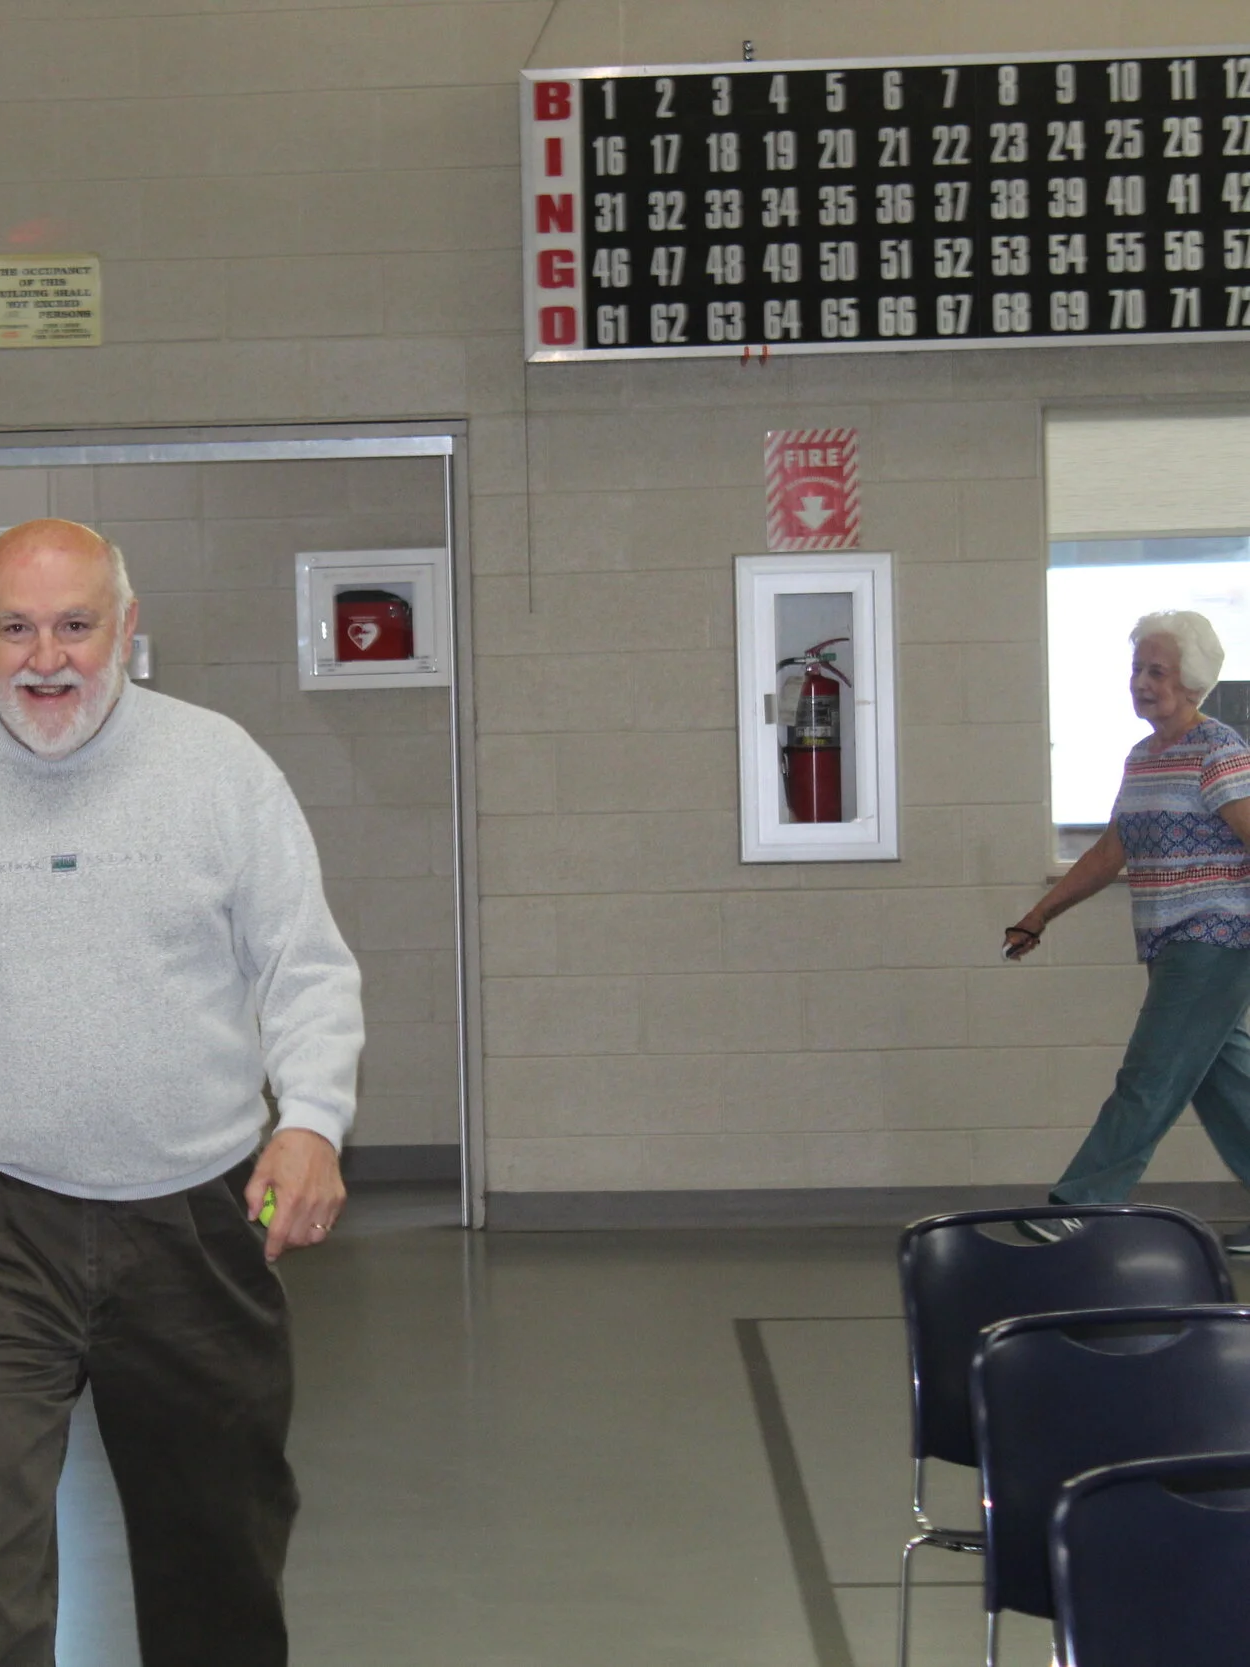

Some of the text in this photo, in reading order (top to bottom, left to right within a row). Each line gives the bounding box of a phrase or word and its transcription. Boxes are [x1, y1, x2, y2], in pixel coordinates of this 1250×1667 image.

[602, 80, 614, 120] 1
[655, 77, 674, 118] 2
[712, 75, 730, 116] 3
[769, 74, 788, 114] 4
[826, 71, 845, 113] 5
[883, 70, 902, 111] 6
[942, 68, 958, 108] 7
[998, 65, 1018, 106] 8
[1056, 63, 1075, 104] 9
[1106, 61, 1141, 103] 10
[1168, 59, 1196, 101] 11
[593, 135, 625, 176] 16
[650, 133, 680, 174] 17
[706, 132, 738, 172] 18
[763, 130, 795, 171] 19
[818, 128, 855, 169] 20
[878, 127, 909, 167] 21
[932, 124, 969, 166] 22
[990, 121, 1027, 163] 23
[1047, 120, 1085, 162] 24
[1105, 118, 1143, 160] 25
[1163, 116, 1202, 158] 26
[595, 192, 625, 233] 31
[648, 190, 685, 231] 32
[705, 188, 741, 229] 33
[762, 186, 799, 228] 34
[819, 185, 856, 226] 35
[876, 183, 913, 224] 36
[934, 181, 969, 222] 37
[990, 178, 1028, 220] 38
[1048, 176, 1086, 218] 39
[1105, 175, 1145, 216] 40
[1167, 173, 1200, 215] 41
[22, 266, 92, 276] OCCUPANCY
[592, 247, 629, 288] 46
[650, 246, 684, 286] 47
[706, 244, 743, 285] 48
[763, 242, 800, 283] 49
[820, 241, 857, 282] 50
[880, 239, 912, 280] 51
[934, 237, 972, 279] 52
[991, 235, 1029, 276] 53
[1048, 233, 1087, 275] 54
[1106, 231, 1145, 273] 55
[1164, 230, 1204, 272] 56
[18, 278, 67, 287] OF THIS
[53, 289, 92, 297] SHALL
[39, 310, 93, 319] PERSONS
[597, 305, 627, 345] 61
[650, 302, 687, 343] 62
[707, 301, 743, 342] 63
[764, 299, 801, 340] 64
[821, 297, 859, 338] 65
[878, 295, 916, 337] 66
[936, 294, 972, 335] 67
[992, 291, 1031, 333] 68
[1050, 290, 1088, 331] 69
[1109, 288, 1146, 330] 70
[1170, 287, 1200, 328] 71
[784, 448, 840, 468] FIRE
